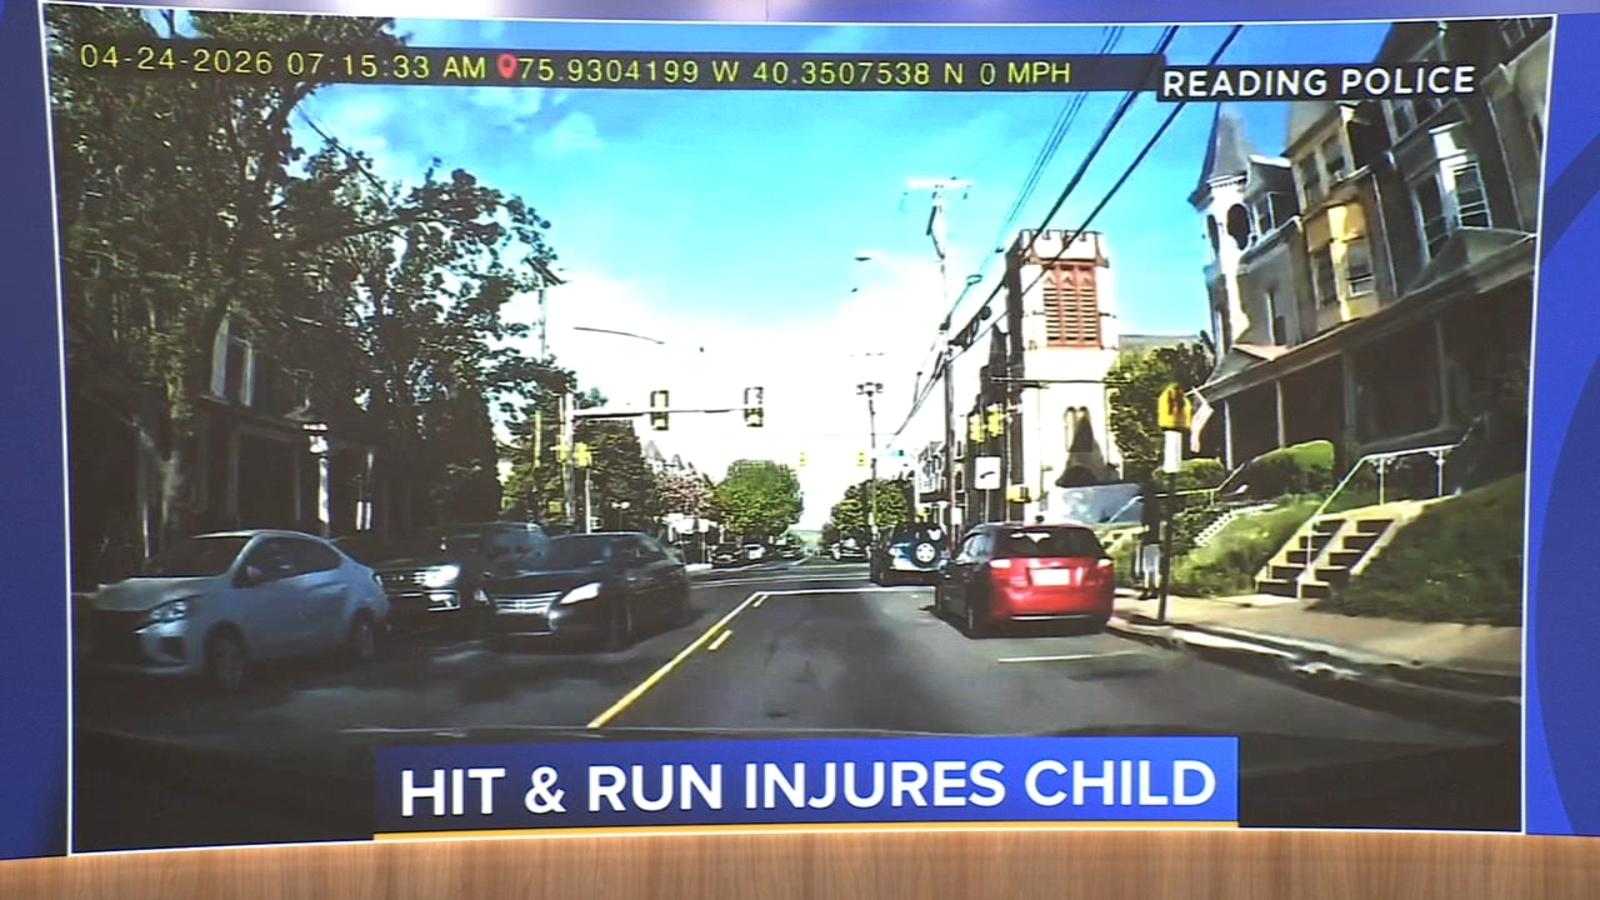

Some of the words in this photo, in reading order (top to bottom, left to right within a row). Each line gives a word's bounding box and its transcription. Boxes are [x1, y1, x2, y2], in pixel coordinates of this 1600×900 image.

[80, 43, 273, 74] 04-24-2026
[286, 51, 431, 78] 07:15:33
[443, 56, 487, 79] AM
[519, 57, 700, 83] 75.9304199
[713, 61, 741, 82] W
[753, 61, 931, 85] 40.3507538
[944, 63, 964, 84] N
[979, 64, 994, 85] 0
[1008, 62, 1071, 84] MPH
[1164, 69, 1327, 97] READING
[1341, 65, 1475, 95] POLICE
[401, 767, 506, 817] HIT
[524, 766, 567, 814] &
[588, 763, 723, 812] RUN
[745, 760, 1006, 809] INJURES
[1024, 759, 1217, 807] CHILD
